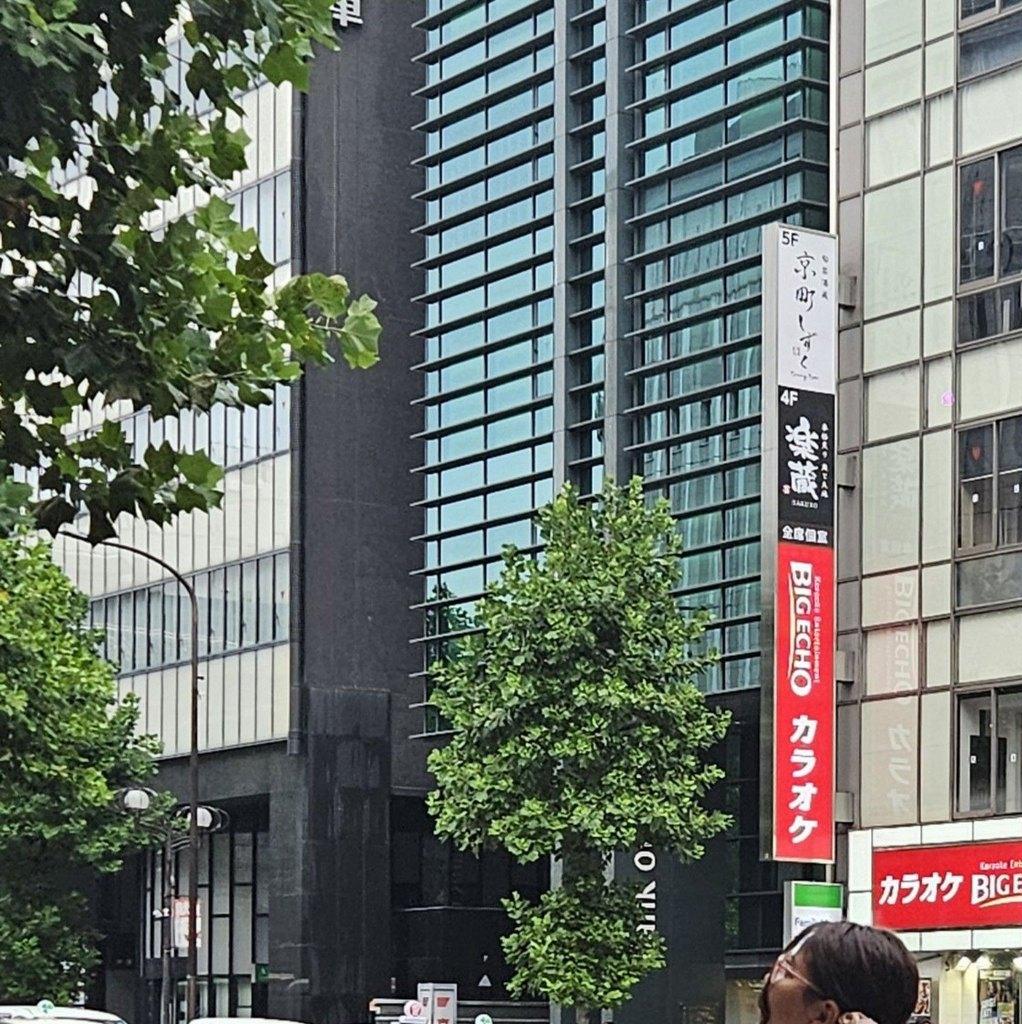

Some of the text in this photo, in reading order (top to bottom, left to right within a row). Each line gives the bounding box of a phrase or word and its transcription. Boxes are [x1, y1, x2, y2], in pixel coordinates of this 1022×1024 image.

[781, 231, 799, 247] 5F
[780, 389, 798, 406] 4F
[785, 416, 819, 500] 楽蔵
[782, 525, 828, 544] 全席個室
[790, 561, 812, 697] BIG ECHO
[788, 715, 818, 844] カラオケ
[878, 871, 963, 905] カラオケ
[971, 873, 1010, 905] BIG
